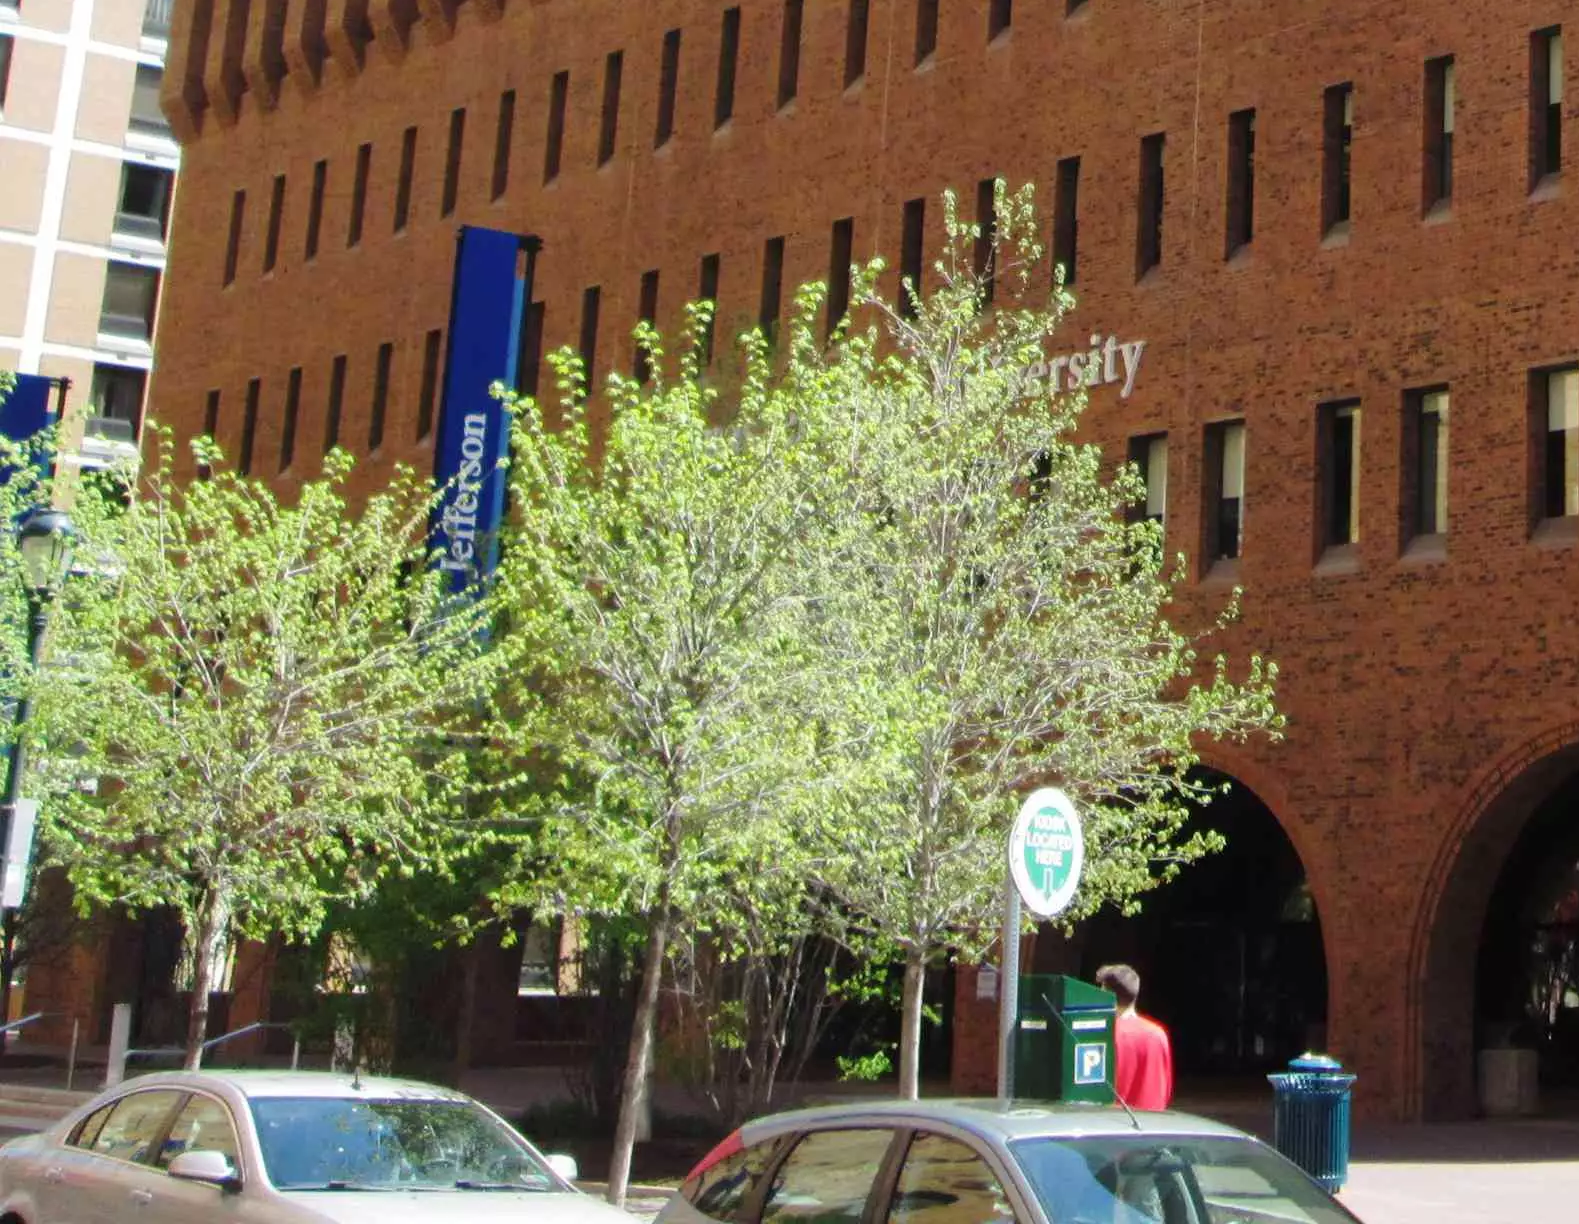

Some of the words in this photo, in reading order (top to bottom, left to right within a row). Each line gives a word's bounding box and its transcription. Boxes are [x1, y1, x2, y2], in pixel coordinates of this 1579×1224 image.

[440, 413, 487, 579] Jefferson
[1026, 832, 1072, 851] LOCATED
[1035, 849, 1063, 867] HERE
[1083, 1050, 1101, 1077] P
